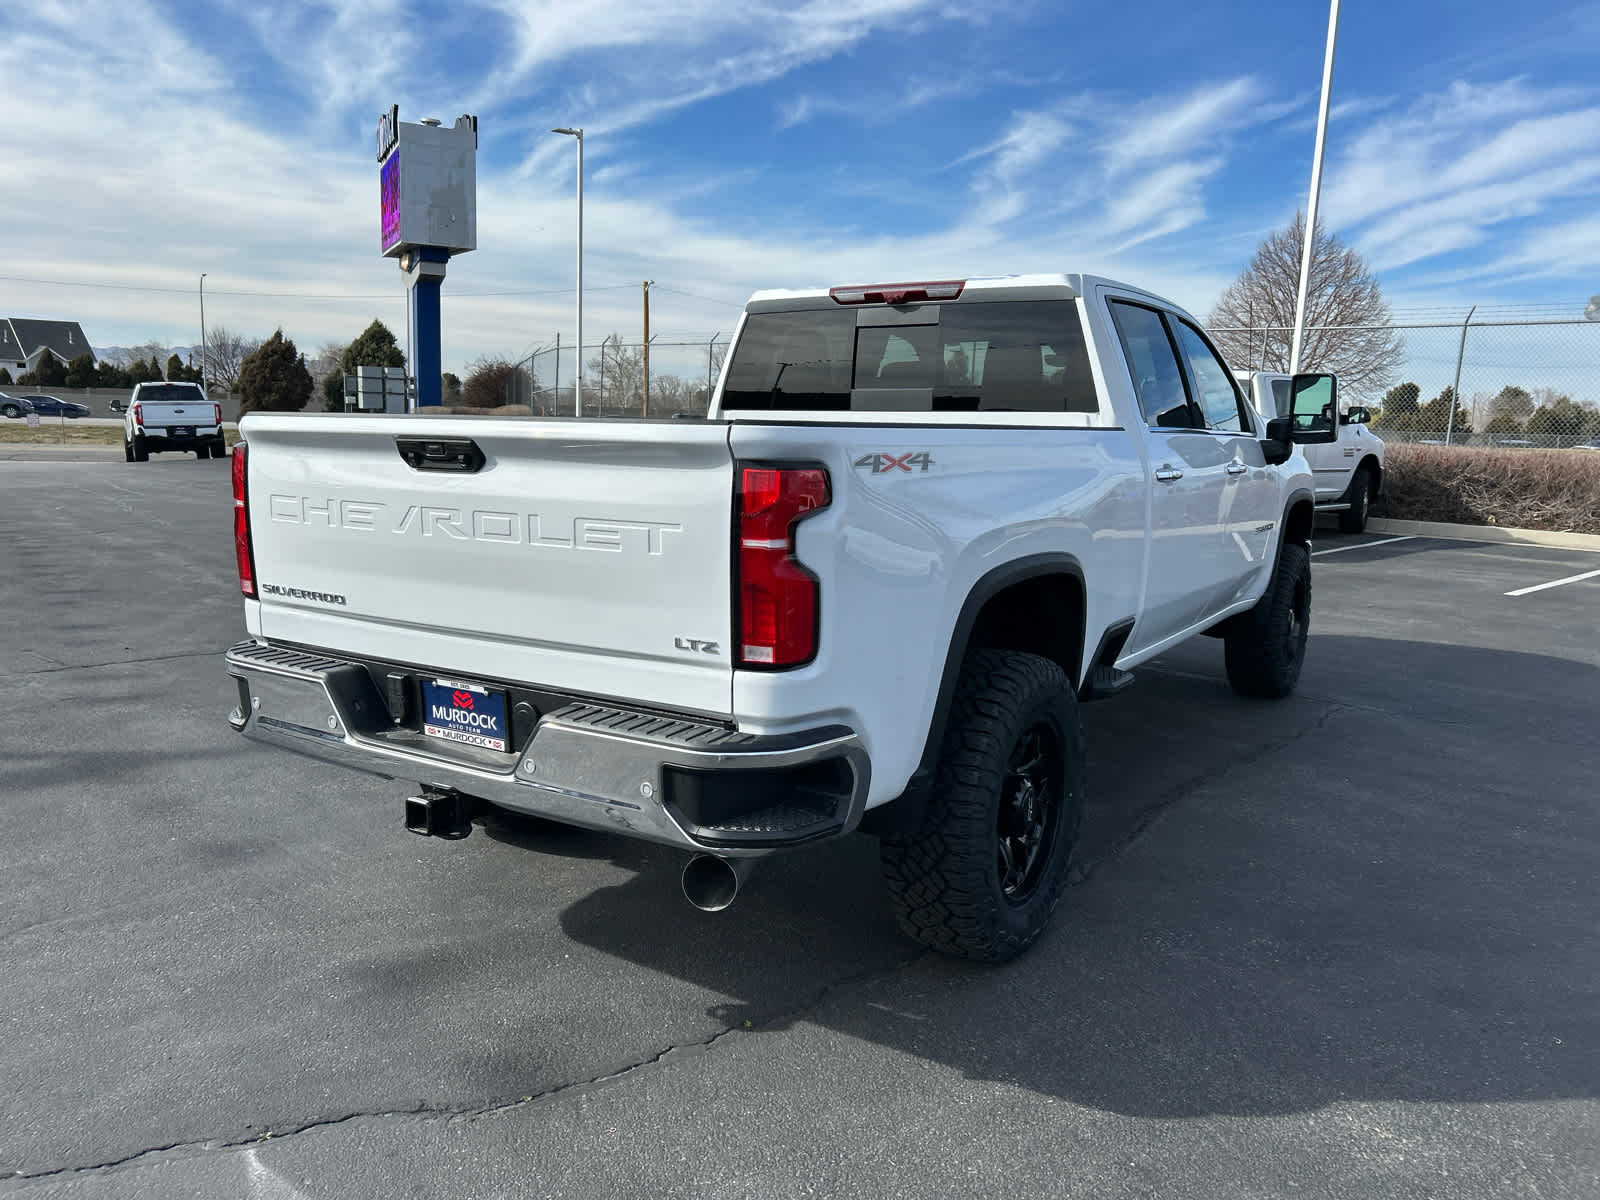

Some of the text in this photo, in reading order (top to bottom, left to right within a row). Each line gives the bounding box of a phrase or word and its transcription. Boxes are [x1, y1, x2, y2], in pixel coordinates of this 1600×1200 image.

[269, 494, 684, 556] CHEVROLET
[262, 583, 347, 606] SILVERADO
[674, 637, 721, 656] LTZ
[432, 705, 497, 730] MURDOCK
[443, 730, 487, 745] MURDOCK
